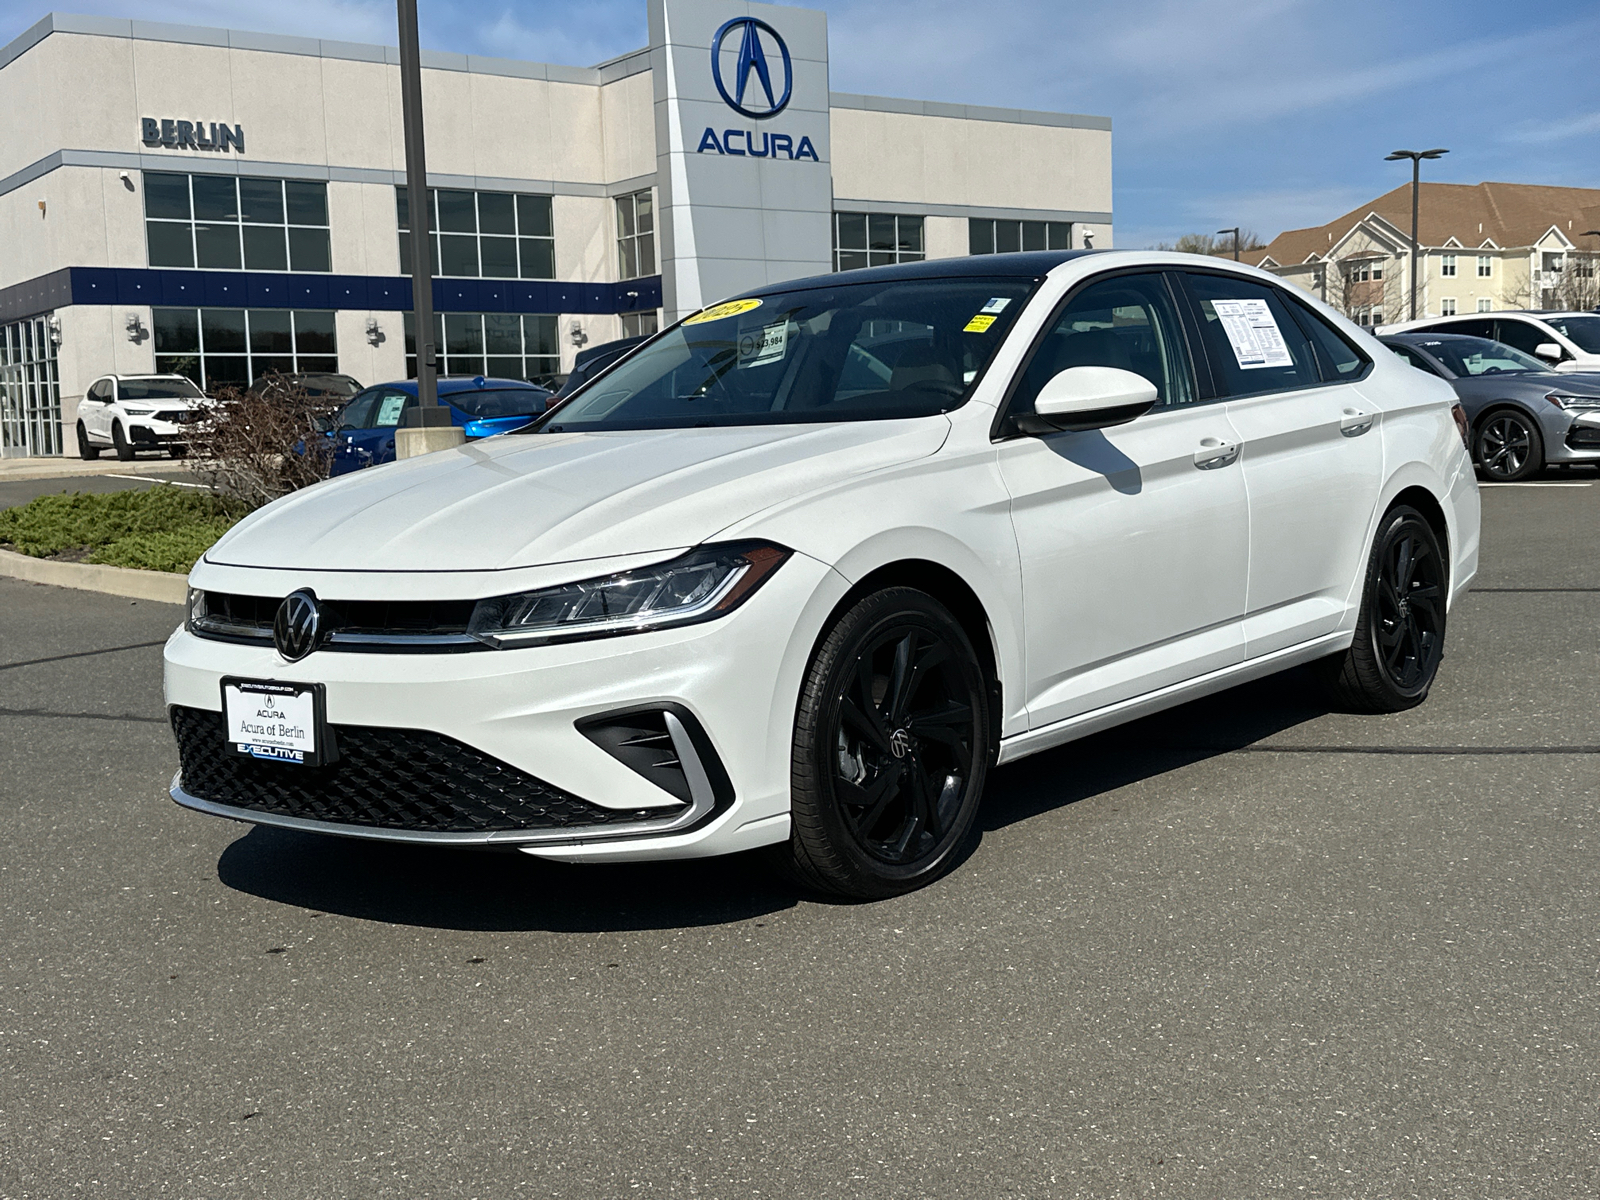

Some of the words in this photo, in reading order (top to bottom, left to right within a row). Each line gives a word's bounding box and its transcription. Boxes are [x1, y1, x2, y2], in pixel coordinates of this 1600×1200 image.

[142, 117, 244, 150] BERLIN
[697, 127, 819, 161] ACURA
[756, 335, 783, 349] $23,984
[256, 710, 286, 719] ACURA
[241, 720, 265, 735] Acura
[267, 724, 276, 736] of
[279, 725, 305, 739] Berlin
[237, 743, 304, 761] EXECUTIVE
